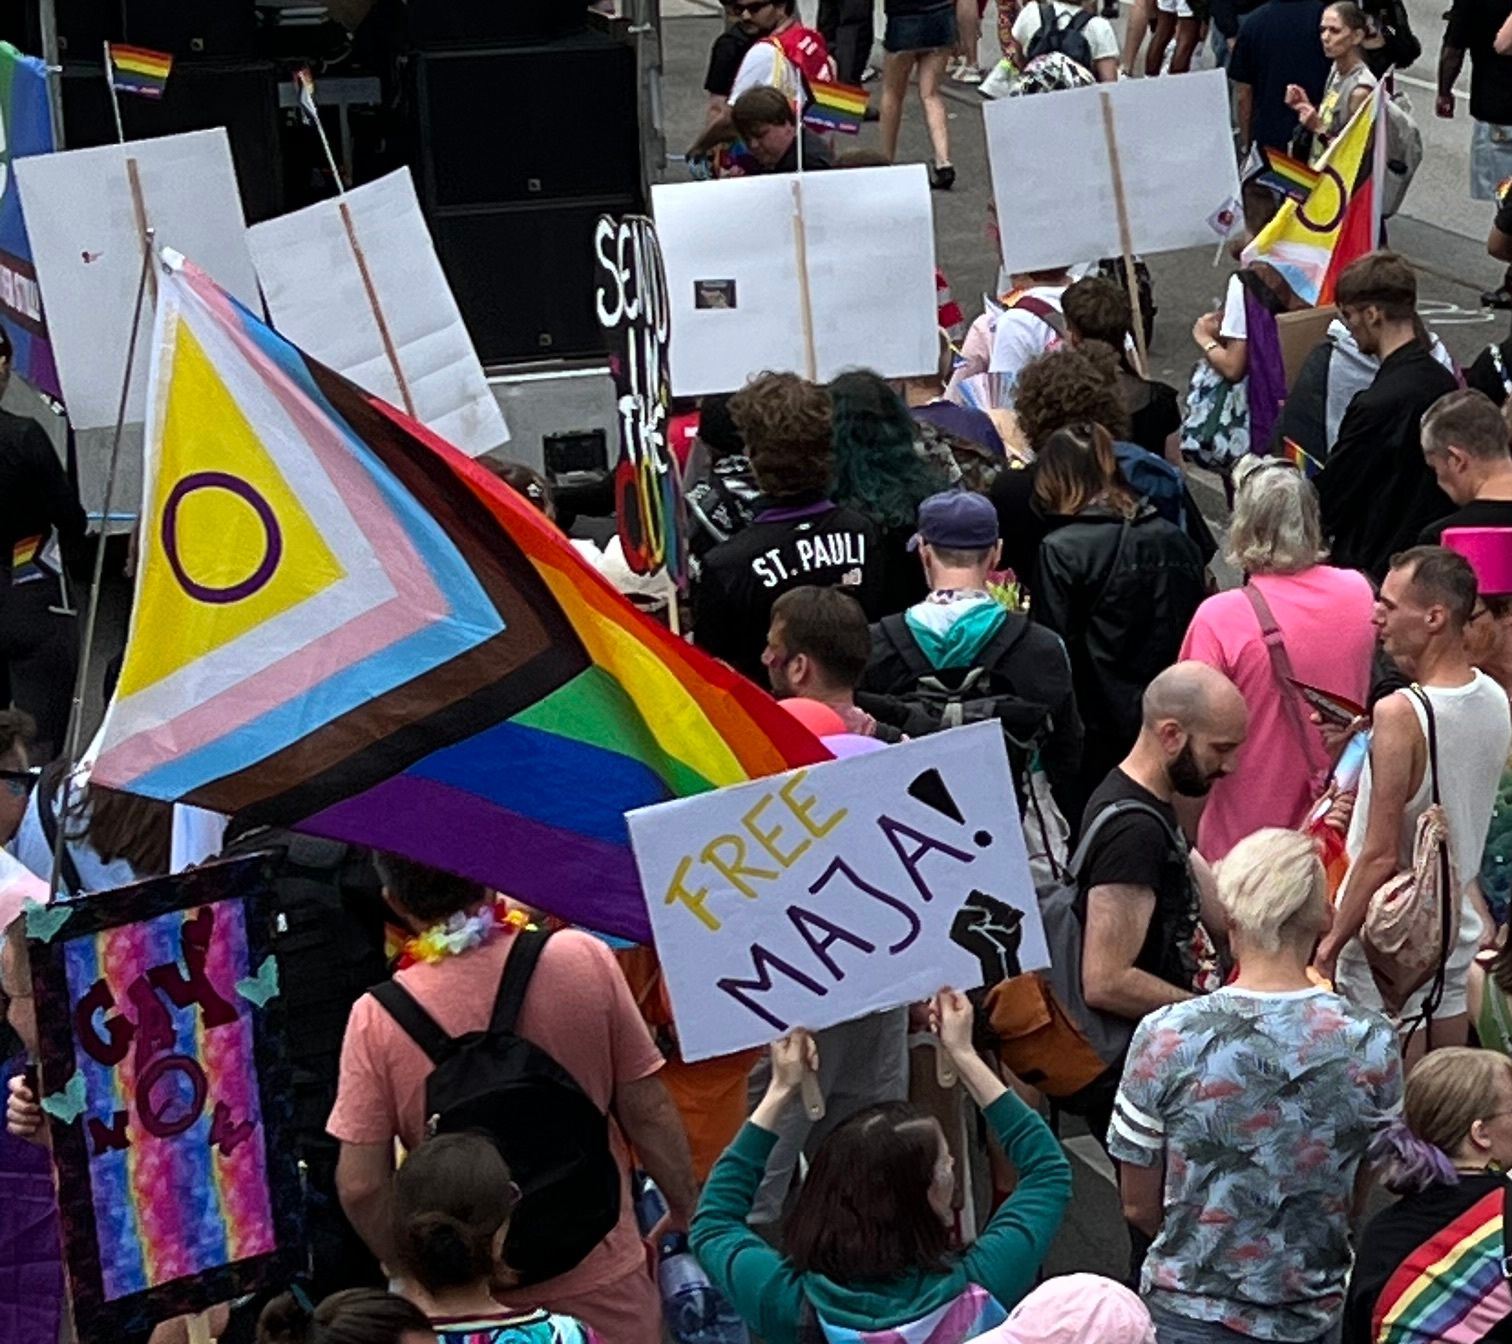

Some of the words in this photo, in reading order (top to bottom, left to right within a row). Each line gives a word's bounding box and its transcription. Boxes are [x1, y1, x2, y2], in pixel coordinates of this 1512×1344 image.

[594, 215, 670, 344] SEND
[751, 547, 798, 588] ST.
[795, 532, 865, 572] PAULI
[666, 771, 847, 932] FREE
[716, 767, 993, 1031] MAJA!
